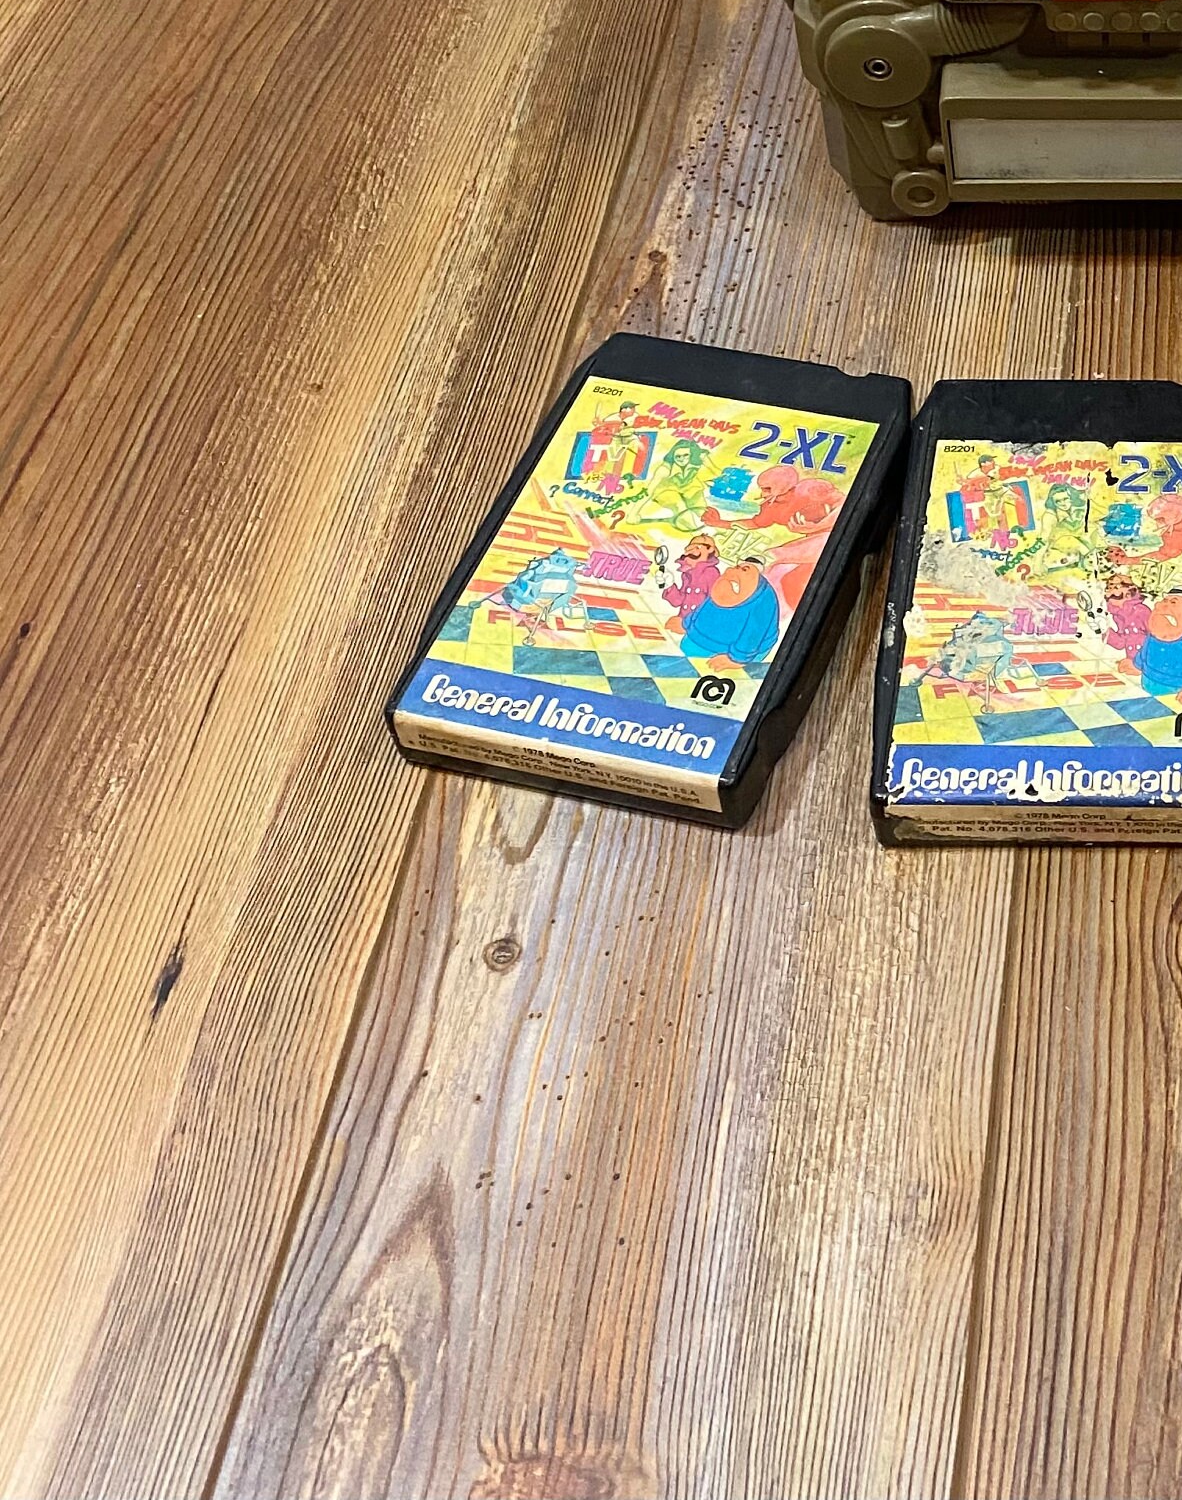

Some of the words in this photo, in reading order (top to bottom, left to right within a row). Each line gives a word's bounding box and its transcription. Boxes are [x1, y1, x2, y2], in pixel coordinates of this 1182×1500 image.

[592, 385, 623, 397] 82201
[589, 444, 628, 462] TV
[739, 422, 847, 474] 2-XL
[943, 445, 975, 453] 82201
[584, 550, 653, 585] TRUE
[422, 673, 544, 724] General
[539, 698, 717, 760] Information
[616, 774, 642, 786] 10010
[902, 758, 1028, 796] General
